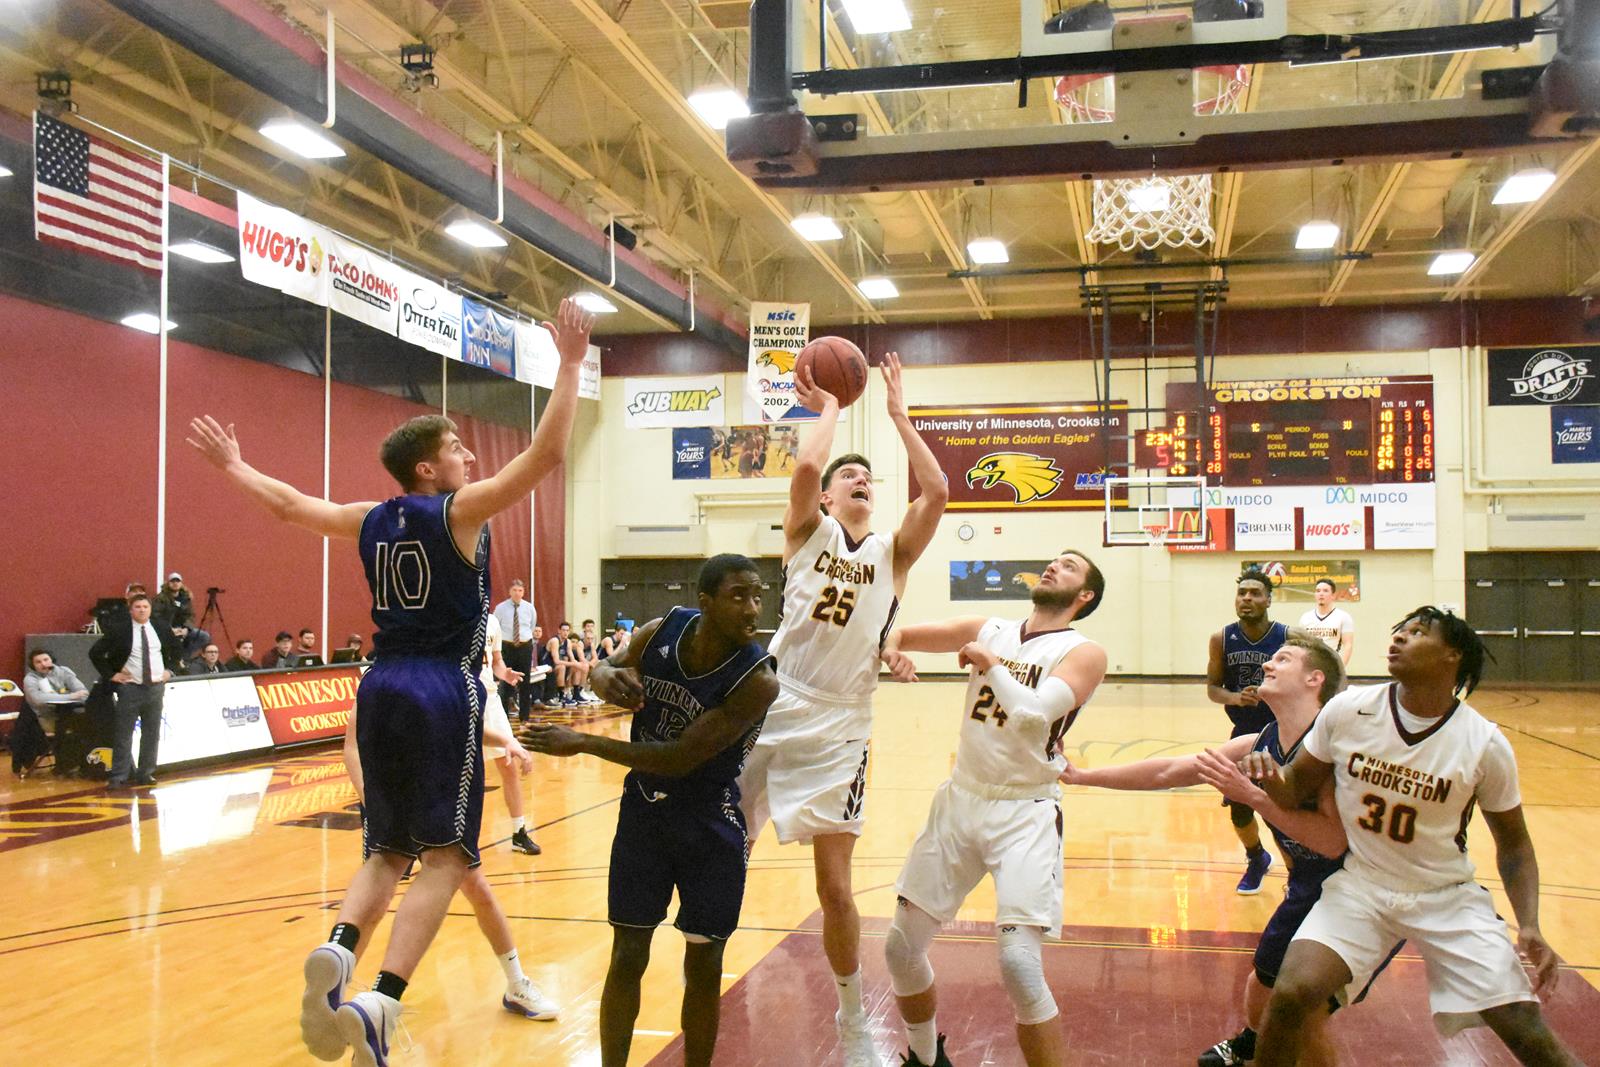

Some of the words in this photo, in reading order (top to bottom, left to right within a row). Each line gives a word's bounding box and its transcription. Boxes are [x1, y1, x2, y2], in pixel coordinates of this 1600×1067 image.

[243, 221, 308, 272] HUGO'S
[328, 254, 359, 283] TACO
[362, 270, 398, 302] JOHN'S
[404, 302, 436, 332] OTTER
[438, 317, 458, 340] TAIL
[754, 326, 780, 336] MEN'S
[784, 326, 806, 336] GOLF
[753, 338, 806, 348] CHAMPIONS
[470, 343, 490, 366] INN
[1514, 362, 1588, 394] DRAFTS
[628, 386, 721, 415] SUBWAY
[1215, 386, 1382, 402] CROOKSTON
[764, 398, 790, 406] 2002
[1381, 410, 1393, 422] 10
[1404, 410, 1412, 421] 3
[1423, 410, 1430, 420] 6
[915, 418, 974, 432] University
[976, 418, 988, 429] of
[991, 417, 1054, 430] Minnesota,
[1381, 422, 1393, 432] 11
[979, 435, 992, 446] of
[993, 434, 1010, 444] the
[1012, 434, 1050, 444] Golden
[1381, 434, 1393, 445] 12
[1556, 430, 1592, 445] YOURS
[676, 449, 704, 464] YOURS
[1377, 458, 1394, 470] 24
[1207, 462, 1221, 473] 28
[1226, 495, 1272, 506] MIDCO
[1360, 492, 1408, 504] MIDCO
[1249, 523, 1292, 532] BREMER
[1306, 523, 1350, 536] HUGO'S
[814, 550, 875, 585] CROKSON
[376, 541, 431, 610] 10
[811, 586, 856, 627] 25
[1227, 651, 1270, 666] WINON
[1239, 666, 1263, 685] 24
[643, 675, 704, 720] WINON
[222, 705, 260, 718] Christian
[971, 685, 1008, 727] 24
[1348, 752, 1452, 803] CROOKSTON
[1366, 757, 1434, 784] MINNESOTA
[1358, 793, 1418, 844] 30
